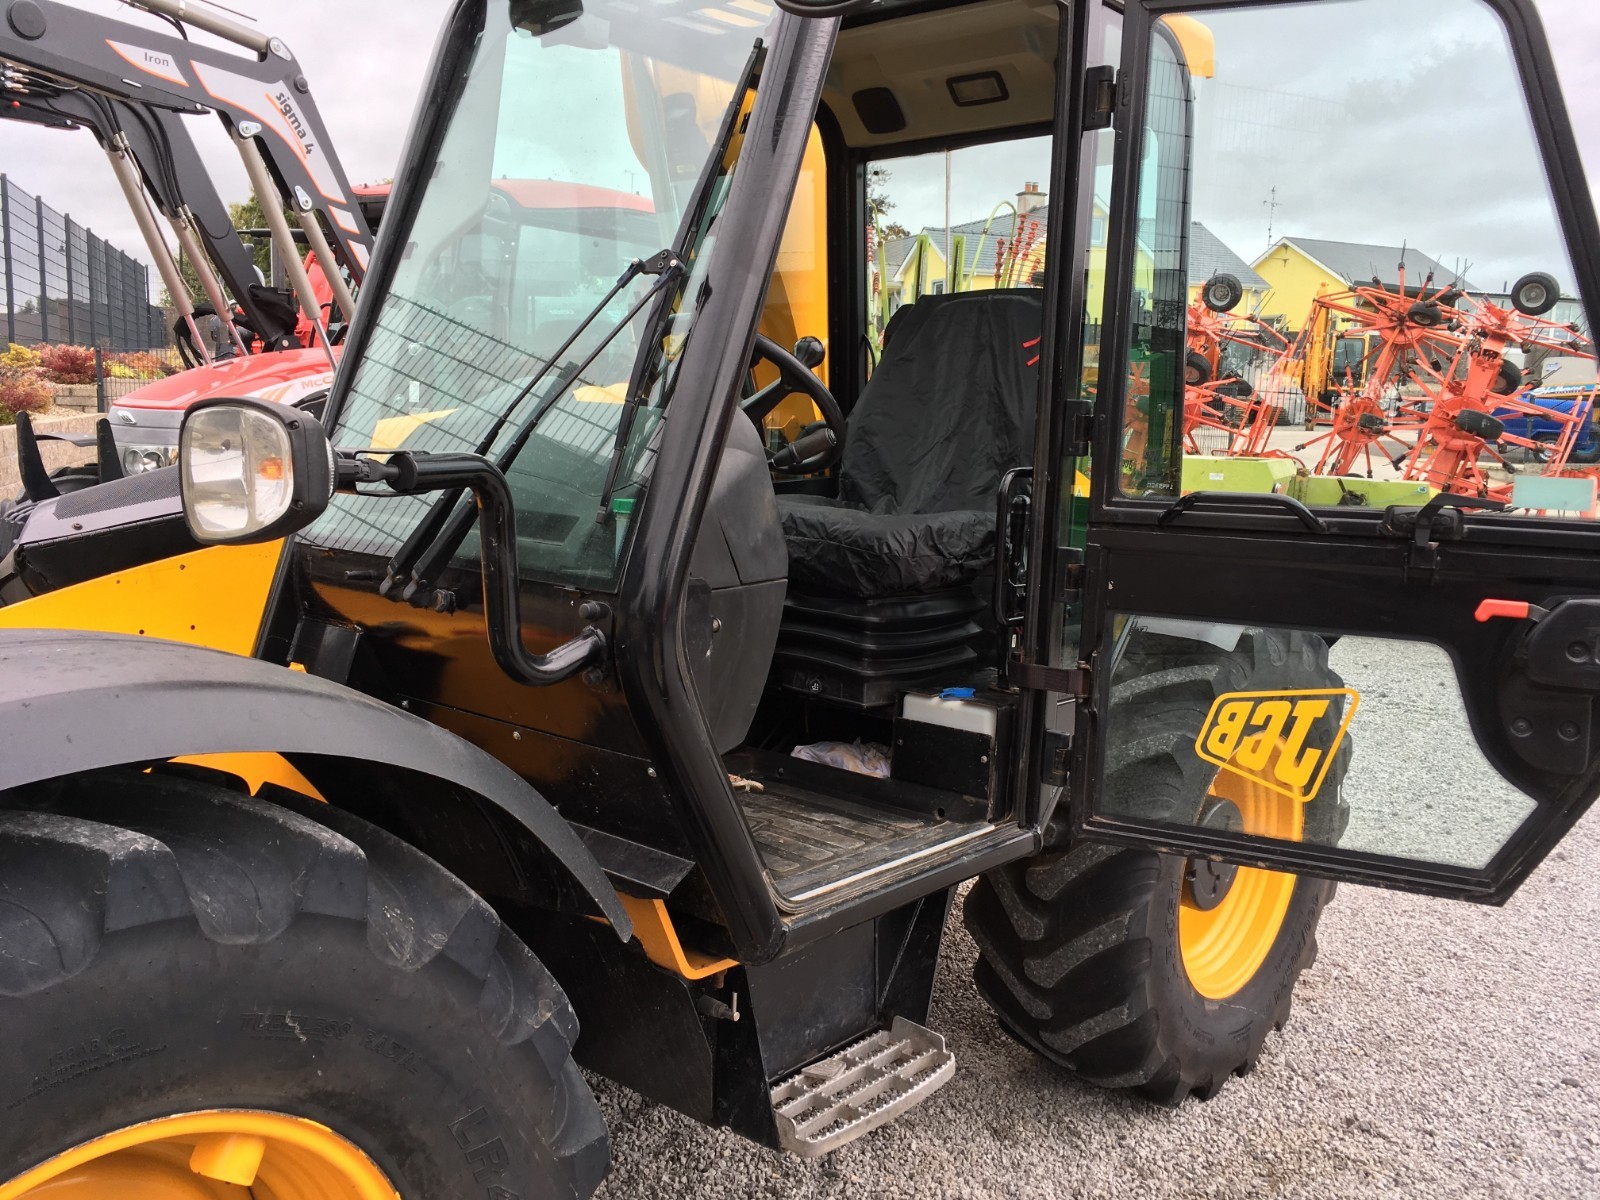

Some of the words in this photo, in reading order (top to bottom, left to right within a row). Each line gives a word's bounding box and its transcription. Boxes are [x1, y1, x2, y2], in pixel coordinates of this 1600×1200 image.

[144, 52, 169, 67] Iron
[276, 92, 307, 140] sigma
[304, 143, 314, 155] 4
[301, 375, 335, 390] McC
